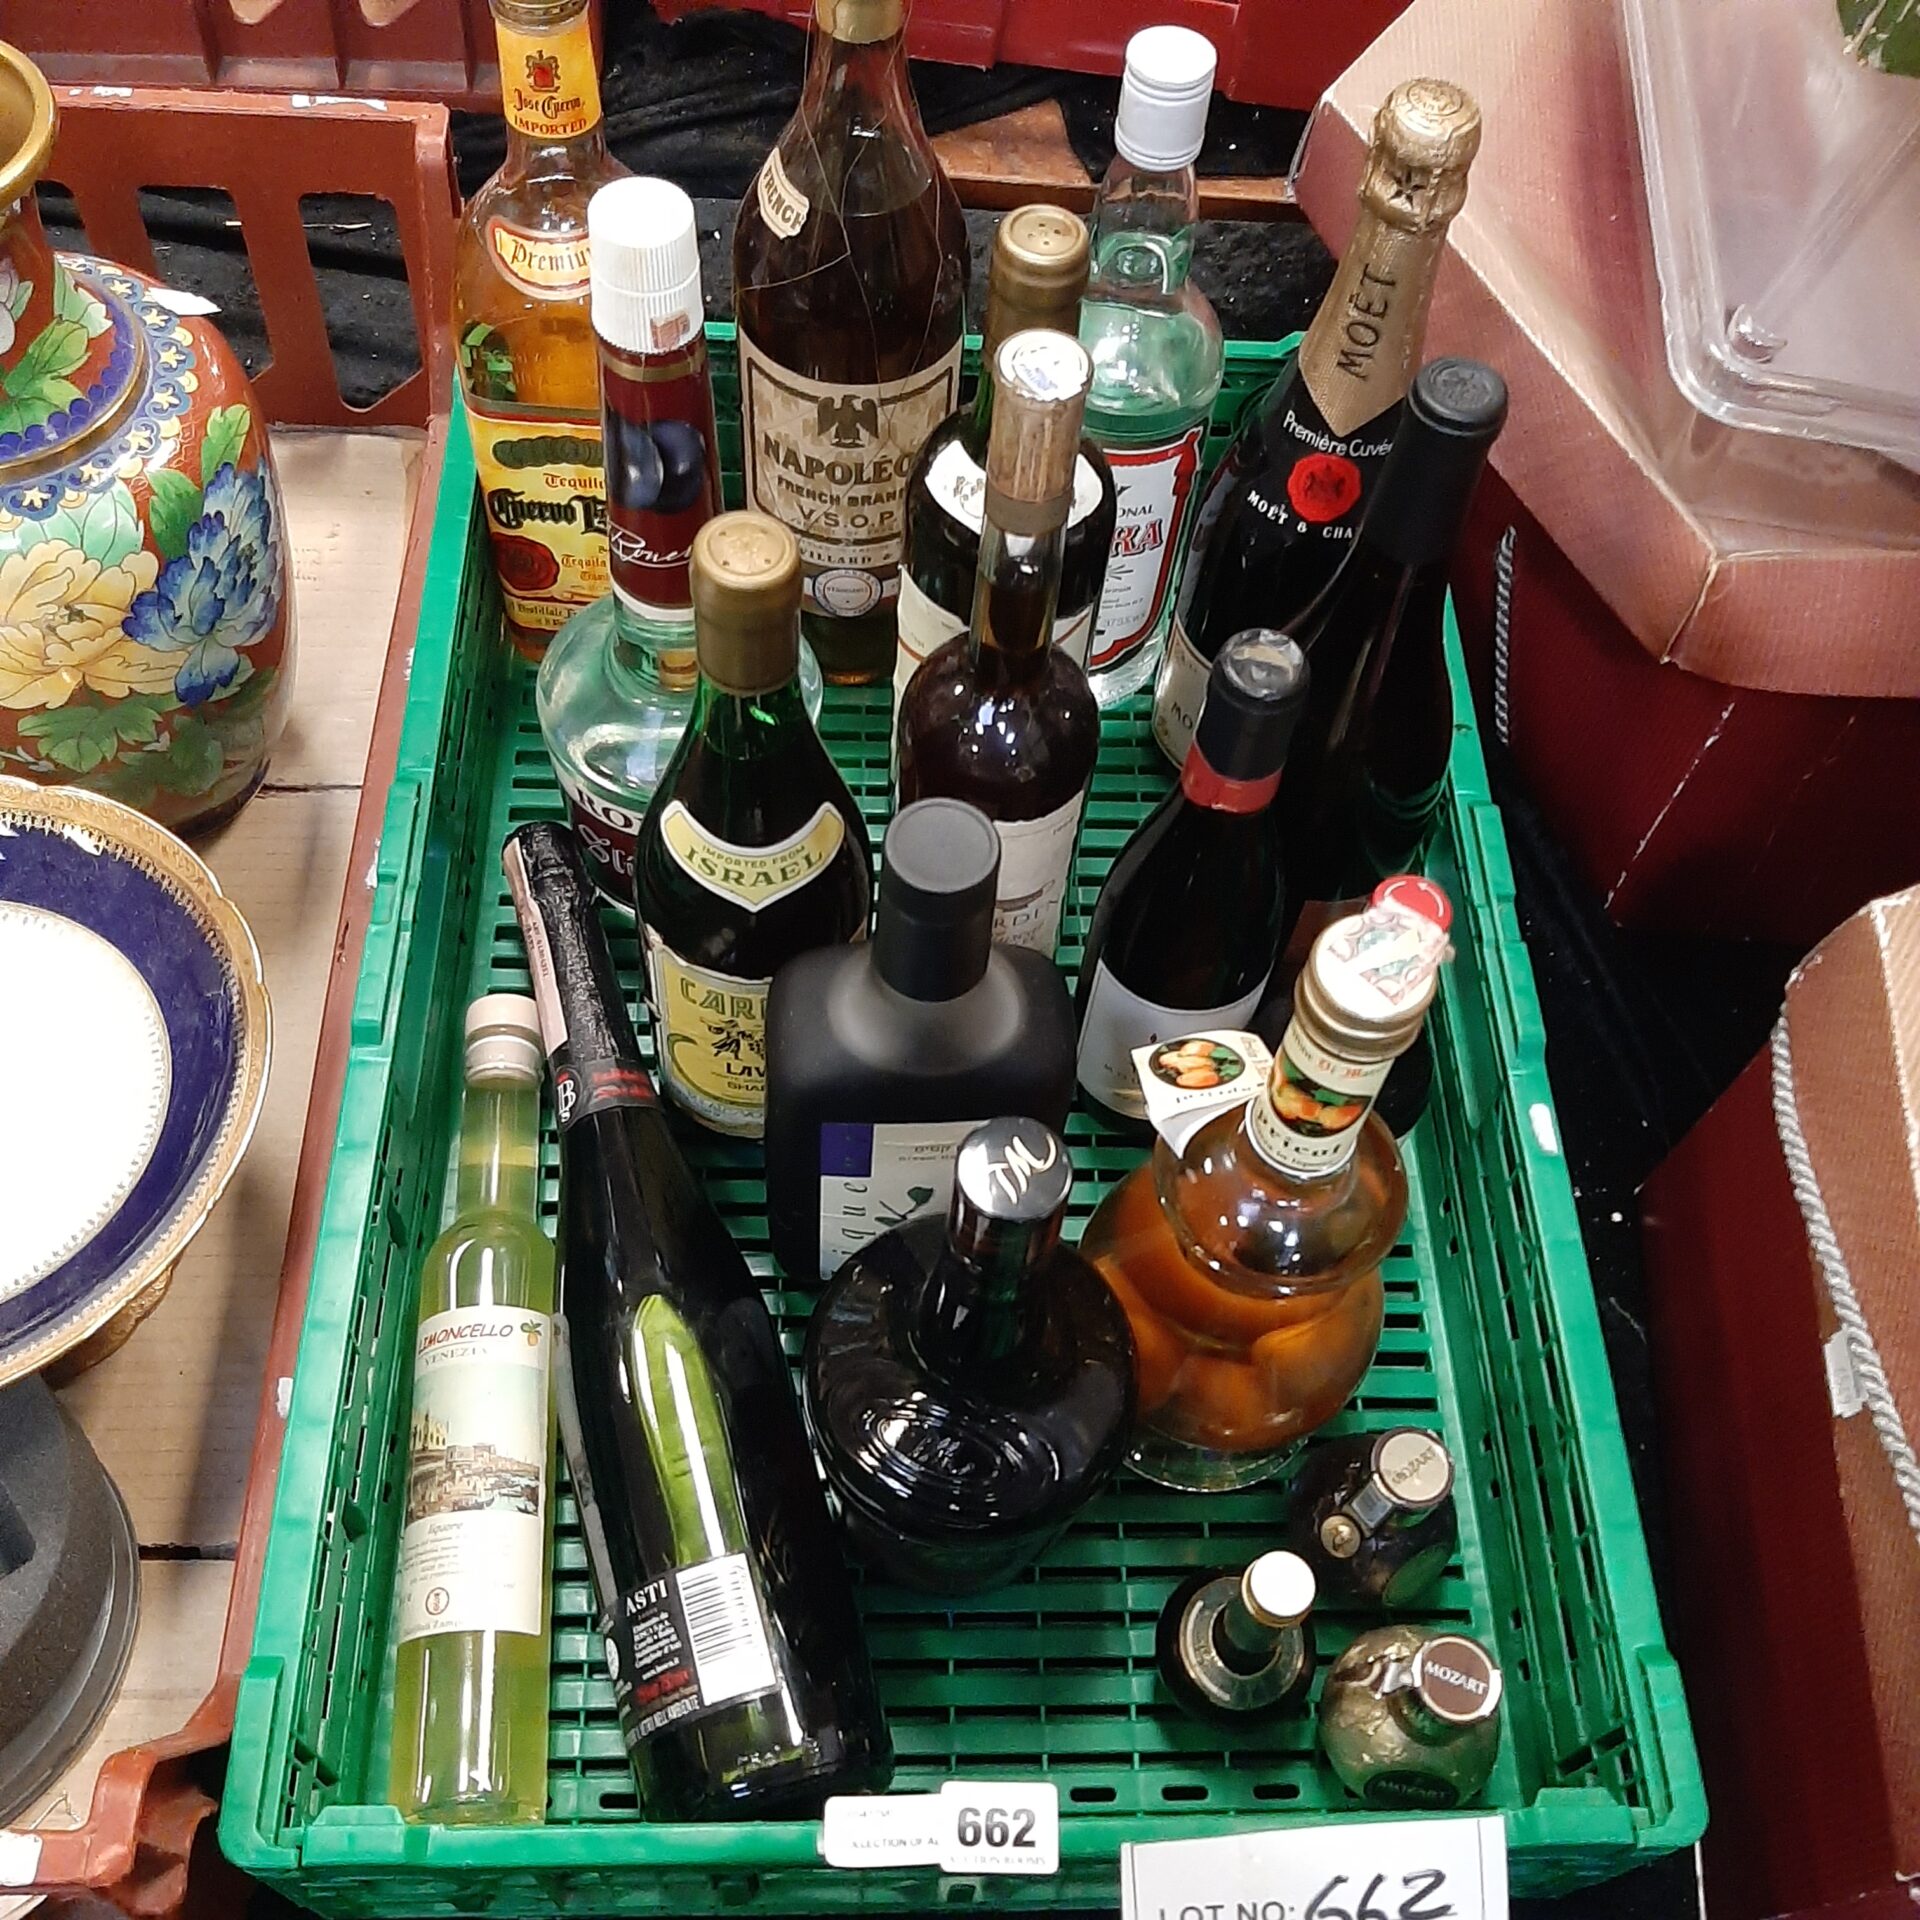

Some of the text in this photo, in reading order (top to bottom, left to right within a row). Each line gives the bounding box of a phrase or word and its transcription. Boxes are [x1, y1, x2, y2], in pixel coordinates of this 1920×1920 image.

[513, 88, 540, 112] Jose
[513, 115, 588, 134] IMPORTED
[762, 164, 806, 231] FRENCH
[510, 238, 591, 272] Premiu
[1282, 410, 1348, 457] Première
[487, 488, 577, 529] Cuervo
[776, 474, 841, 506] FRENCH
[685, 847, 824, 888] ISRAEL
[701, 844, 806, 868] IMPORTED FROM
[418, 1323, 515, 1354] LIMONCELLO
[624, 1578, 669, 1617] ASTI
[1423, 1660, 1488, 1697] MOZART
[956, 1806, 1037, 1849] 662
[1303, 1868, 1458, 1920] 662
